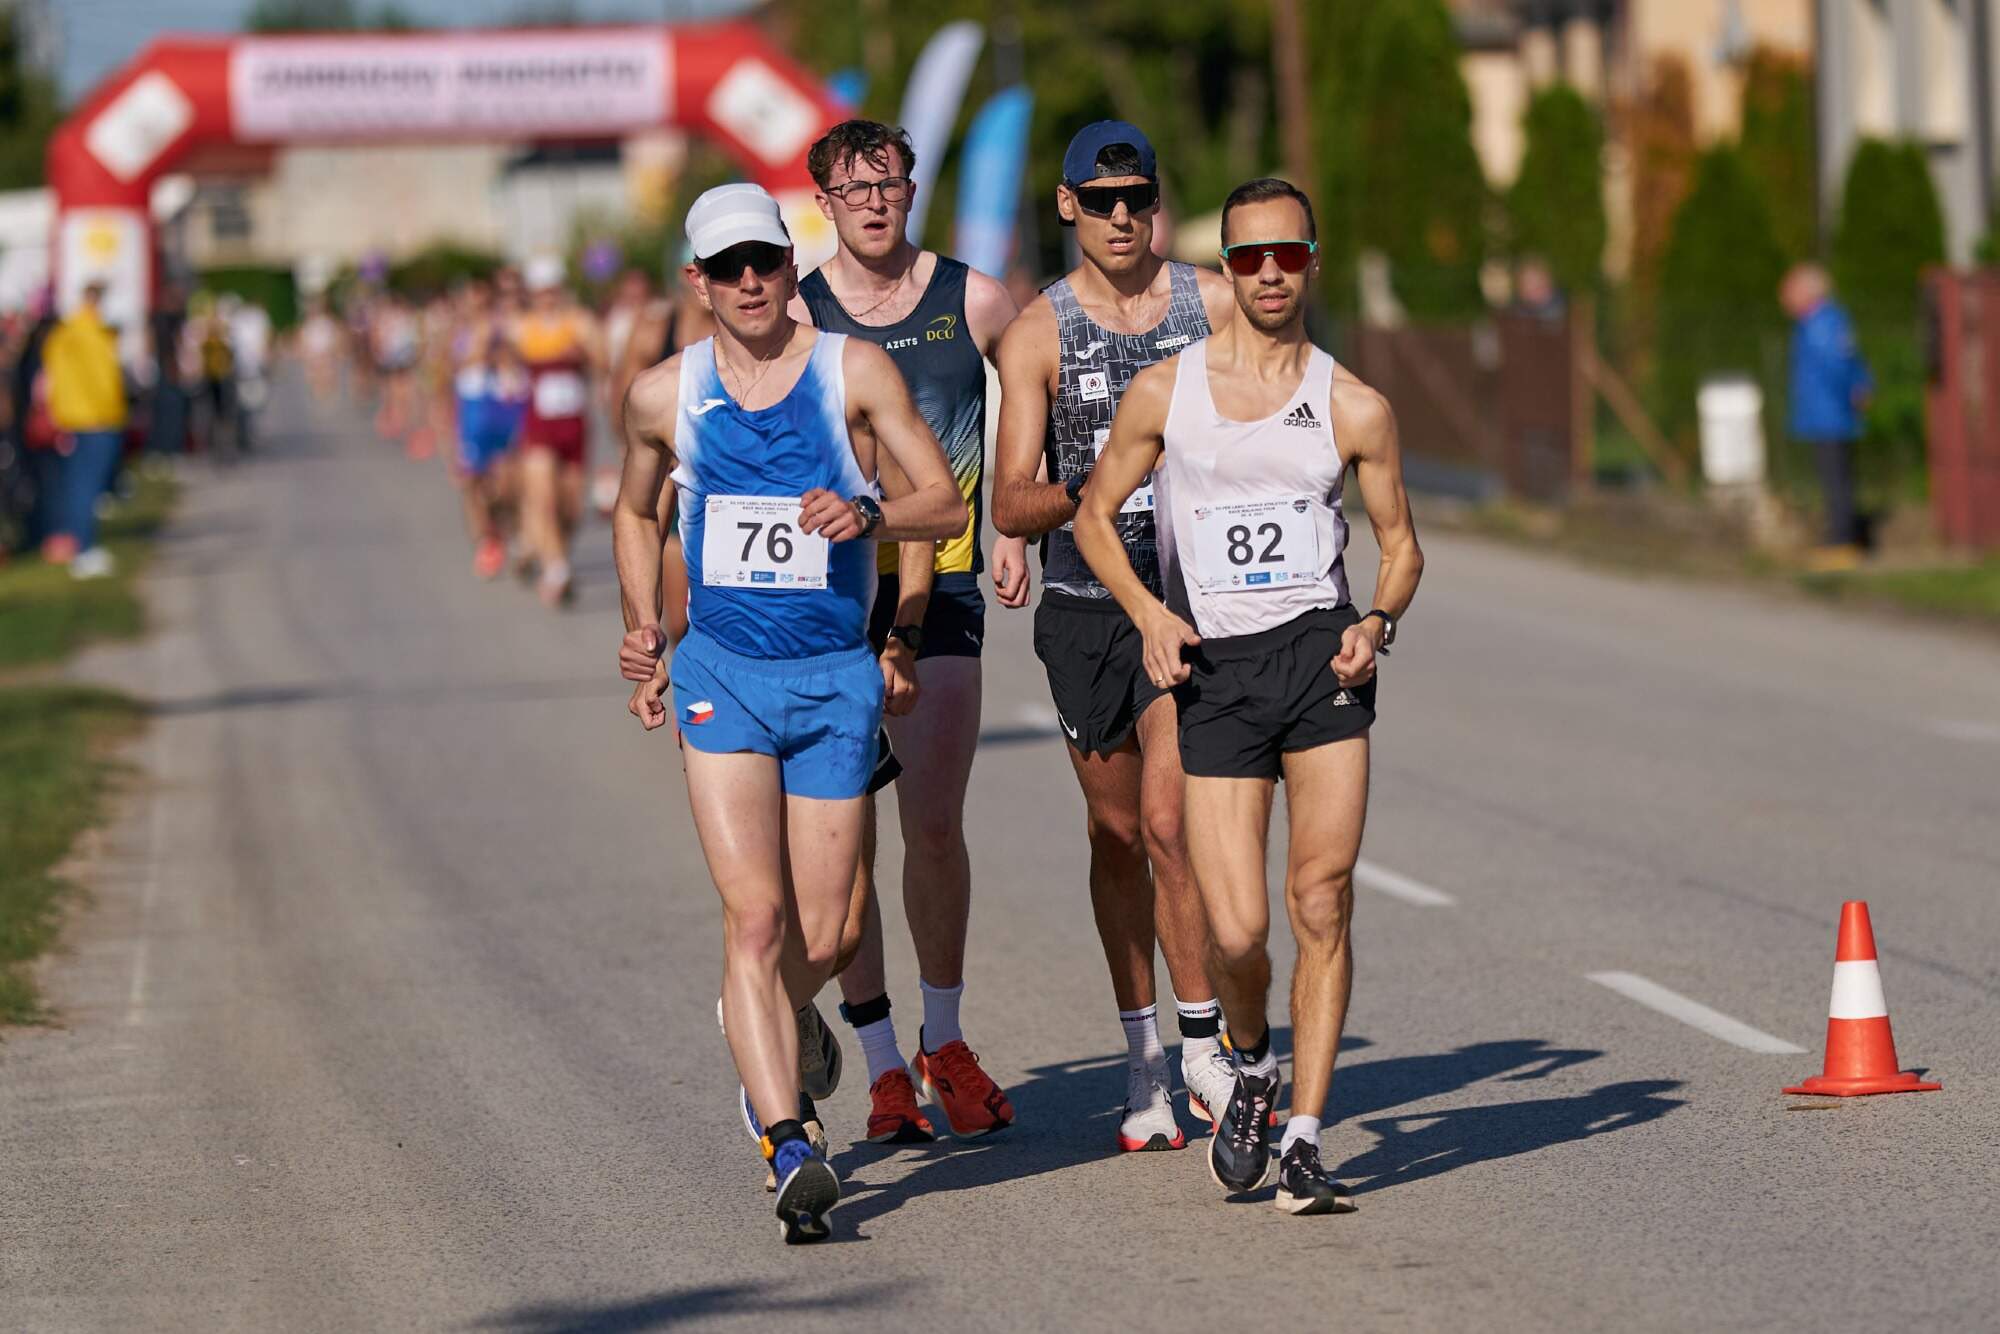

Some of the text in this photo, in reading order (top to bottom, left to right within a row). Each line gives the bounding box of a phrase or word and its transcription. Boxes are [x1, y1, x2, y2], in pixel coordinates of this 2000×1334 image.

[926, 329, 954, 341] DCU
[886, 338, 918, 350] AZETS
[1283, 417, 1322, 429] adidas
[737, 522, 793, 564] 76
[1227, 523, 1285, 566] 82
